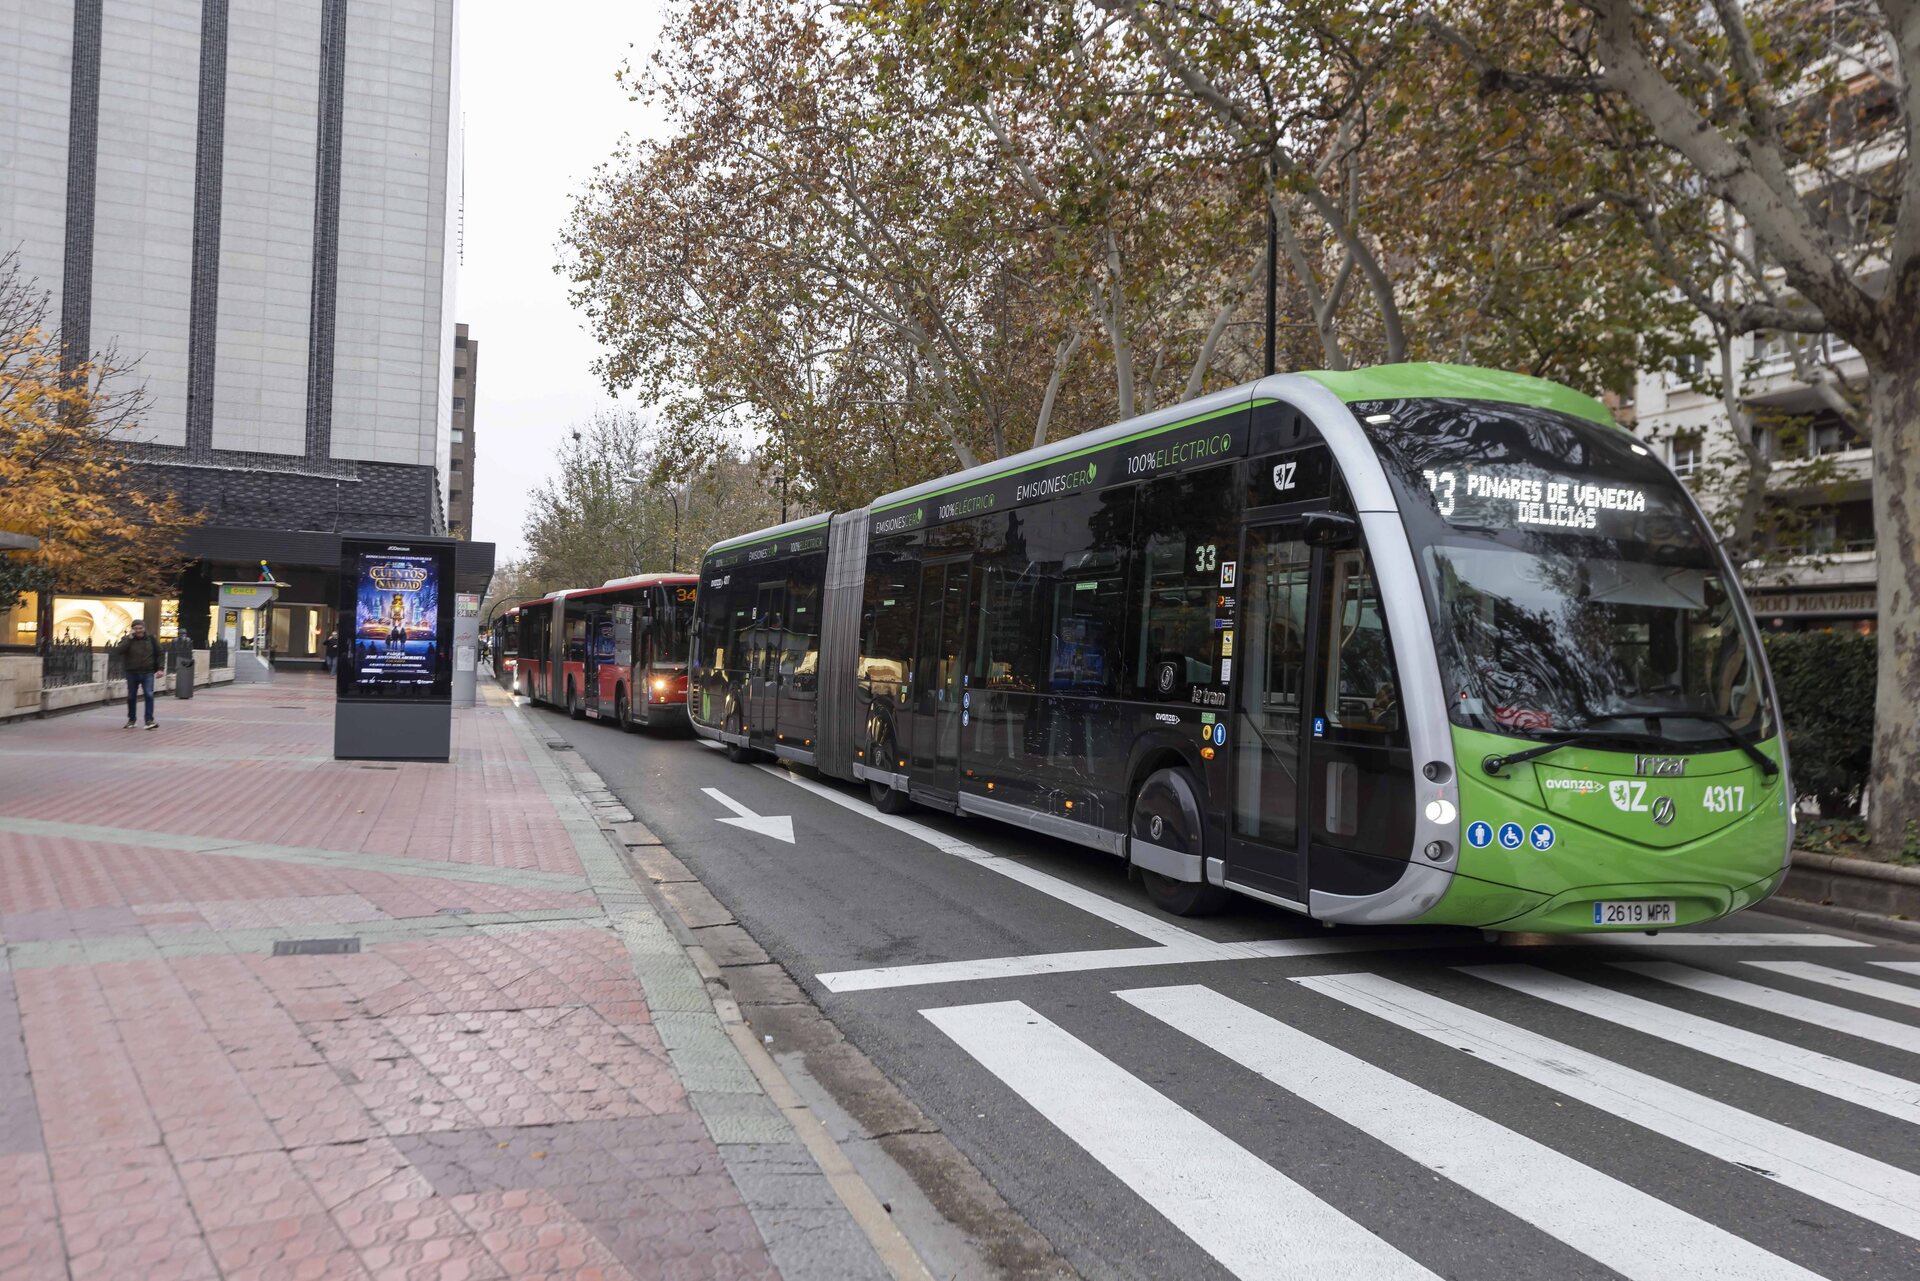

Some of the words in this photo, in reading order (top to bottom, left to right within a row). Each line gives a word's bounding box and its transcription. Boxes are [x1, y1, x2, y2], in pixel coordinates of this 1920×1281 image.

[1467, 474, 1542, 502] PINARES
[1547, 482, 1569, 504] DE
[1574, 485, 1646, 512] VENECIA
[1518, 502, 1596, 529] DELICIAS
[1195, 544, 1217, 571] 33
[372, 567, 425, 580] CUENTOS
[378, 580, 420, 590] NAVIDAD
[676, 588, 697, 602] 34
[1203, 688, 1226, 706] tram
[1155, 712, 1175, 722] avanza
[1546, 779, 1594, 789] avanza
[1703, 785, 1744, 812] 4317
[1607, 905, 1643, 922] 2619
[1647, 904, 1671, 921] MPR
